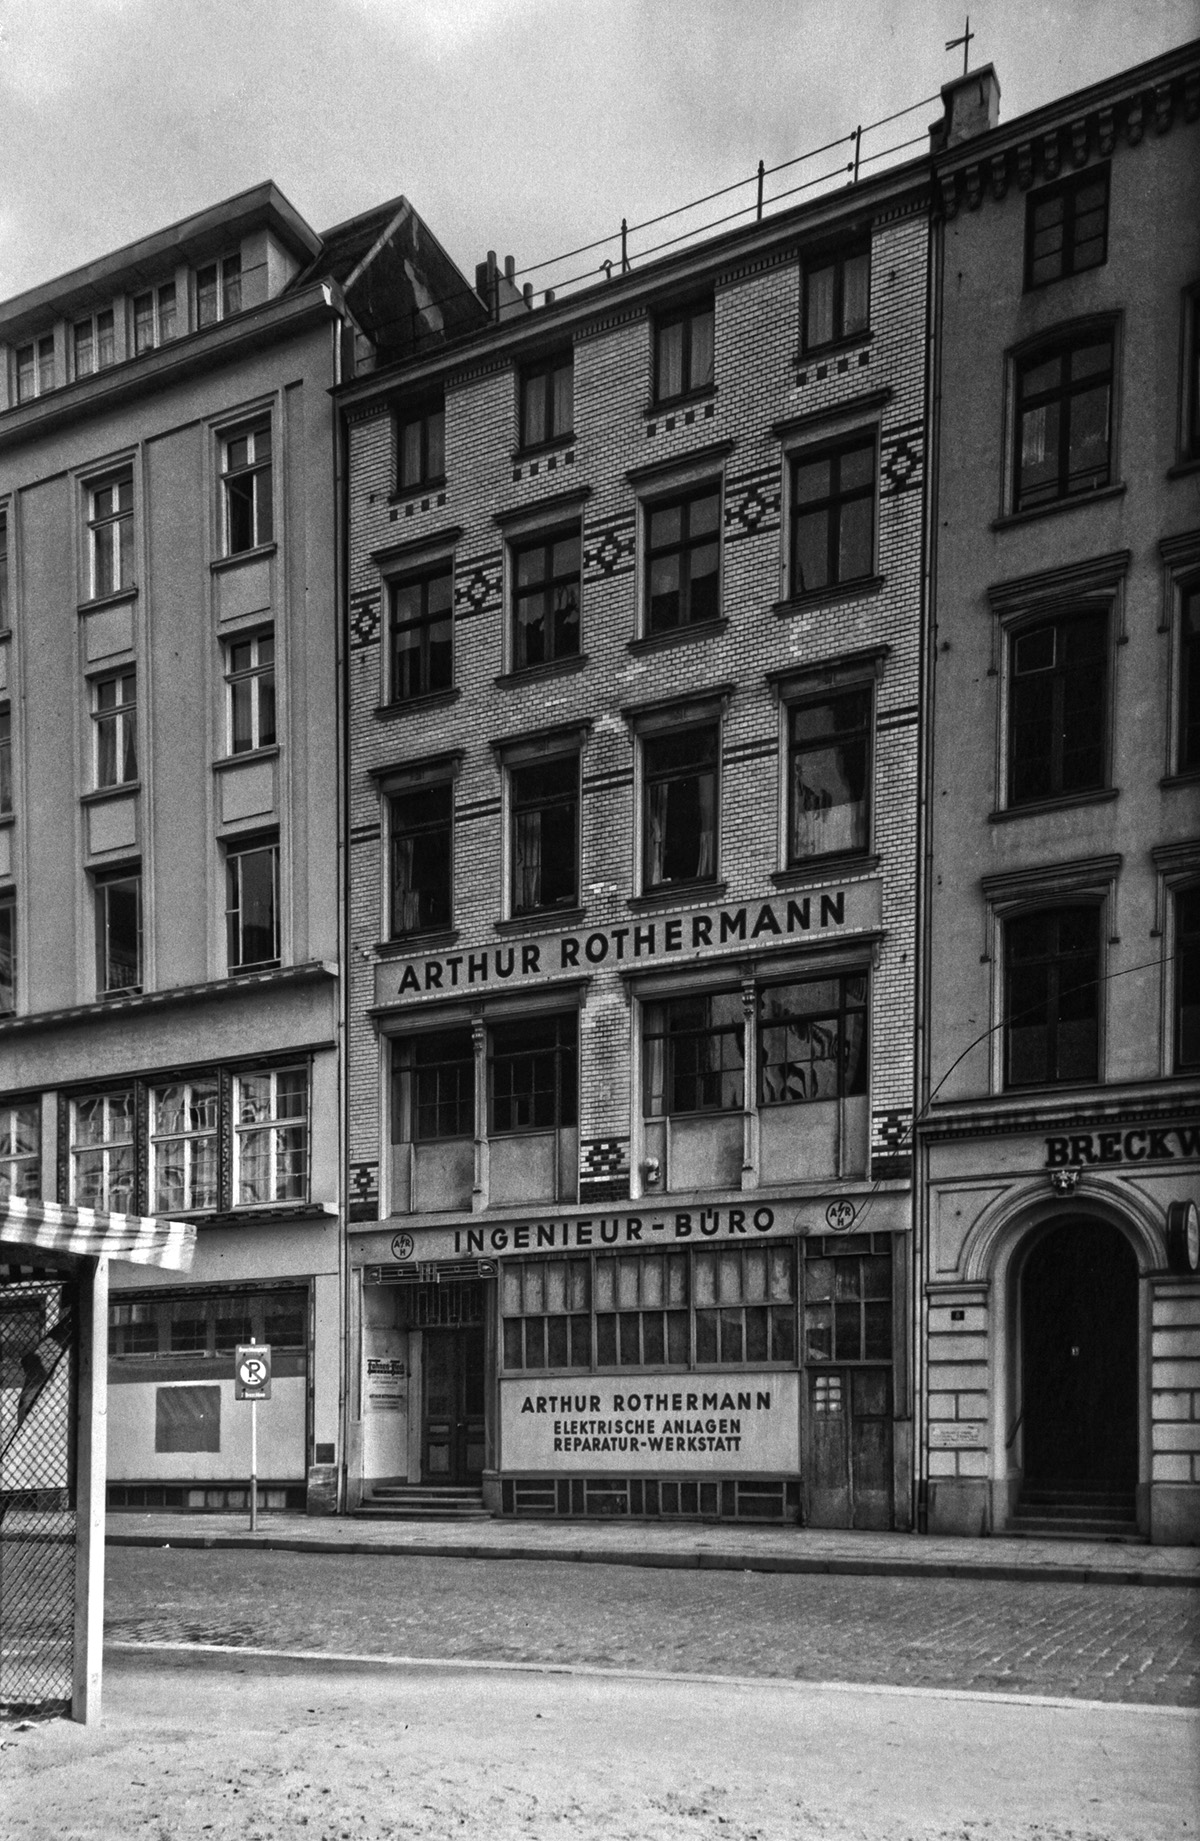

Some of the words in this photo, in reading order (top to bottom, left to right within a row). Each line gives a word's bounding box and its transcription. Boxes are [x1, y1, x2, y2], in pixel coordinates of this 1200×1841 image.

[397, 944, 541, 994] ARTHUR
[560, 892, 846, 968] ROTHERMANN
[249, 1362, 260, 1378] P
[521, 1395, 601, 1413] ARTHUR
[613, 1392, 771, 1411] ROTHERMANN
[554, 1420, 655, 1434] ELEKTRISCHE
[662, 1419, 741, 1434] ANLAGEN
[554, 1436, 742, 1451] REPARATUR-WERKSTATT
